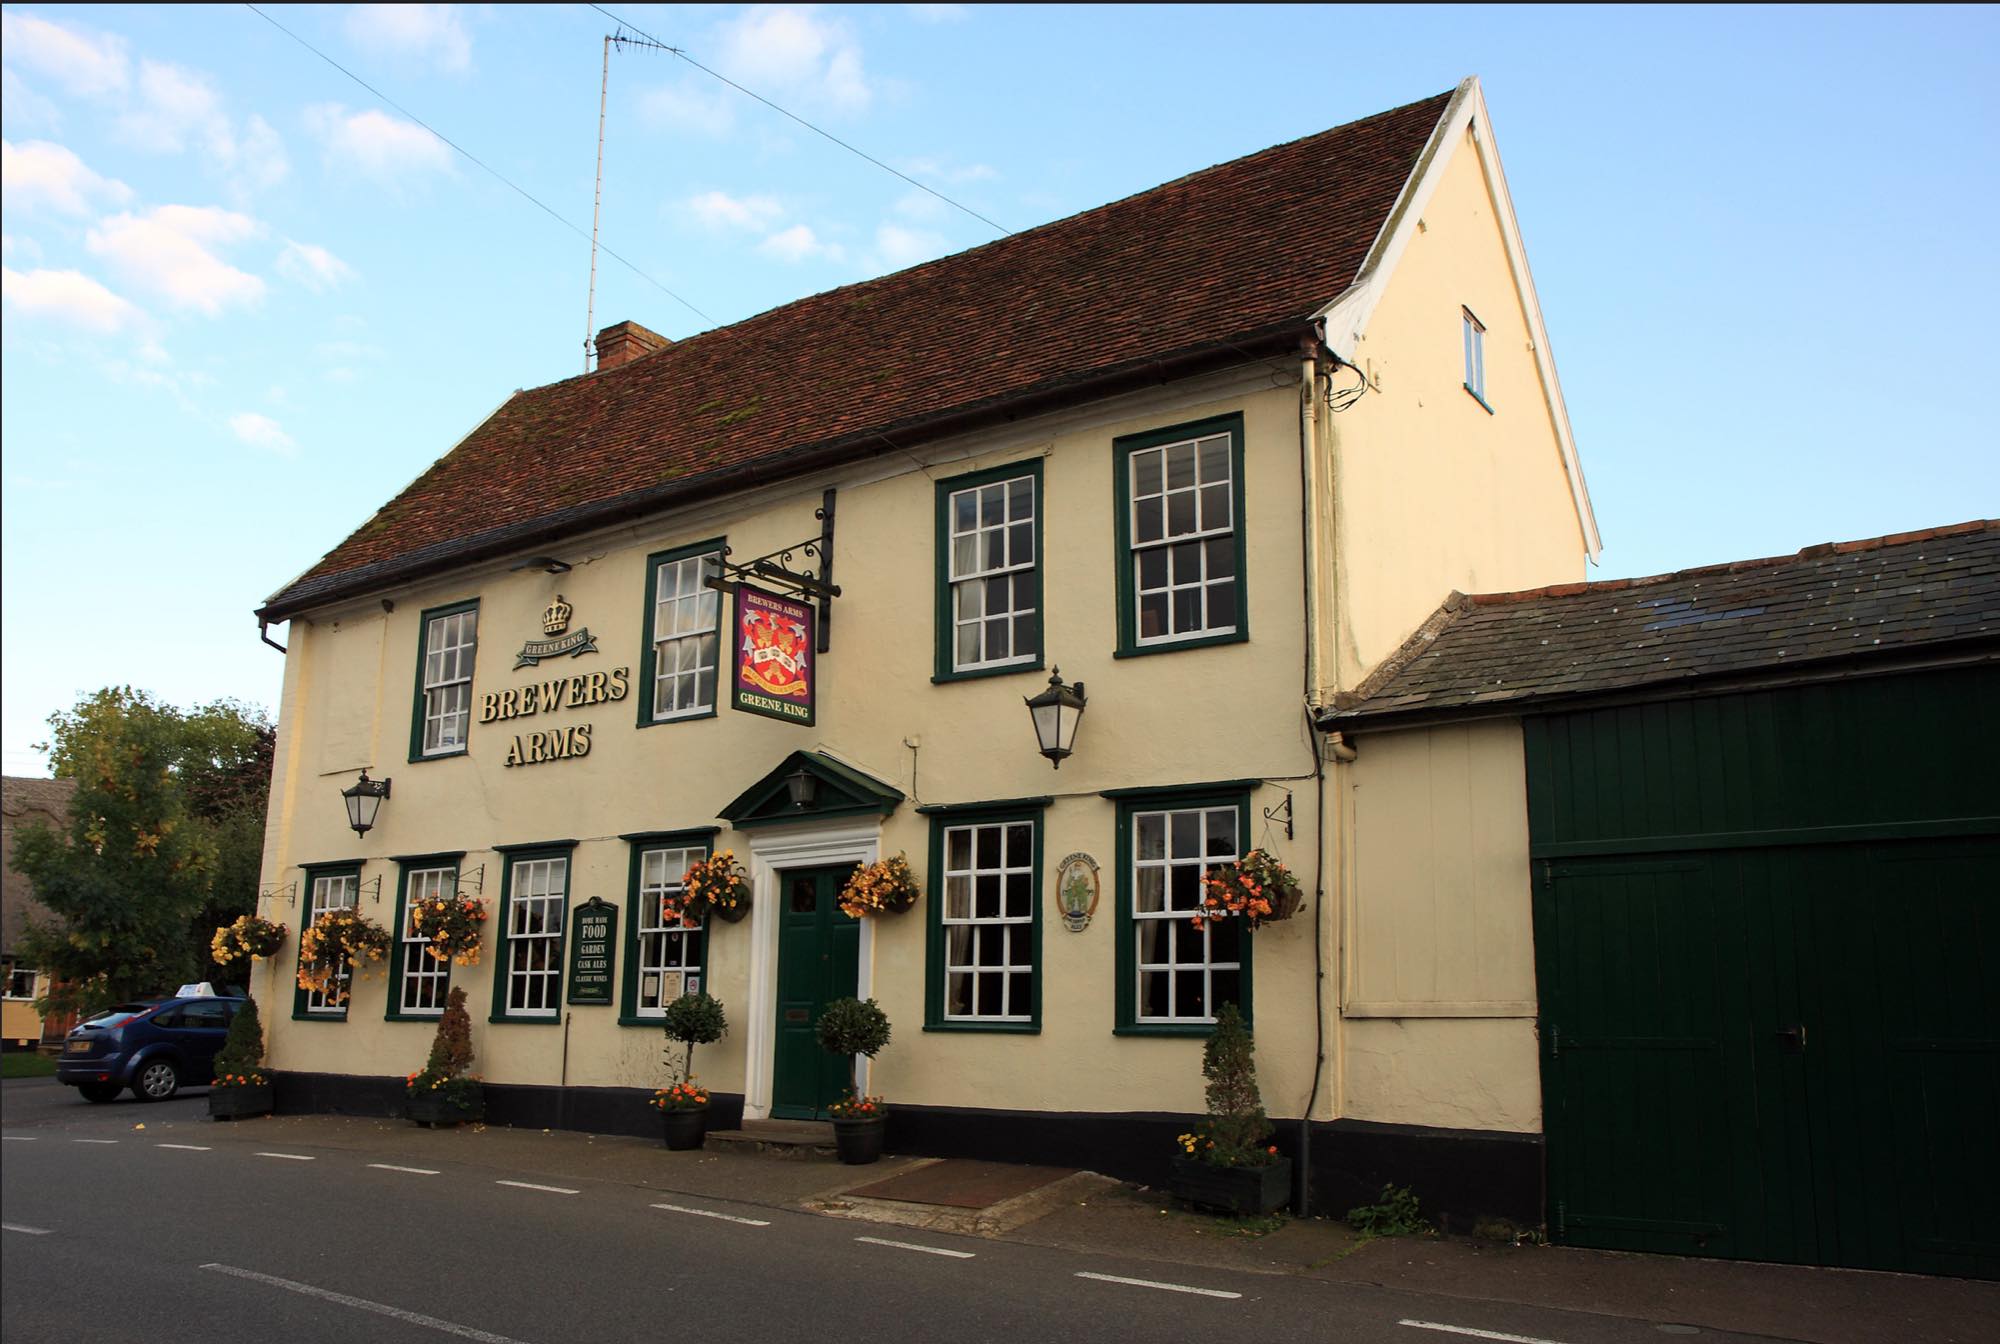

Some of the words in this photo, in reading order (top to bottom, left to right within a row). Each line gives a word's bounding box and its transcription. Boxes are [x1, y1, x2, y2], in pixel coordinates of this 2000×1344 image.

[747, 594, 782, 612] BREWERS
[783, 605, 804, 618] ARMS
[525, 640, 559, 655] GREENE
[560, 632, 583, 649] KING
[479, 667, 629, 724] BREWERS
[740, 692, 782, 712] GREENE
[783, 702, 808, 718] KING
[504, 724, 592, 767] ARMS
[582, 924, 606, 938] FOOD
[581, 944, 605, 954] GARDEN
[577, 960, 591, 969] CASK
[592, 960, 607, 969] ALES
